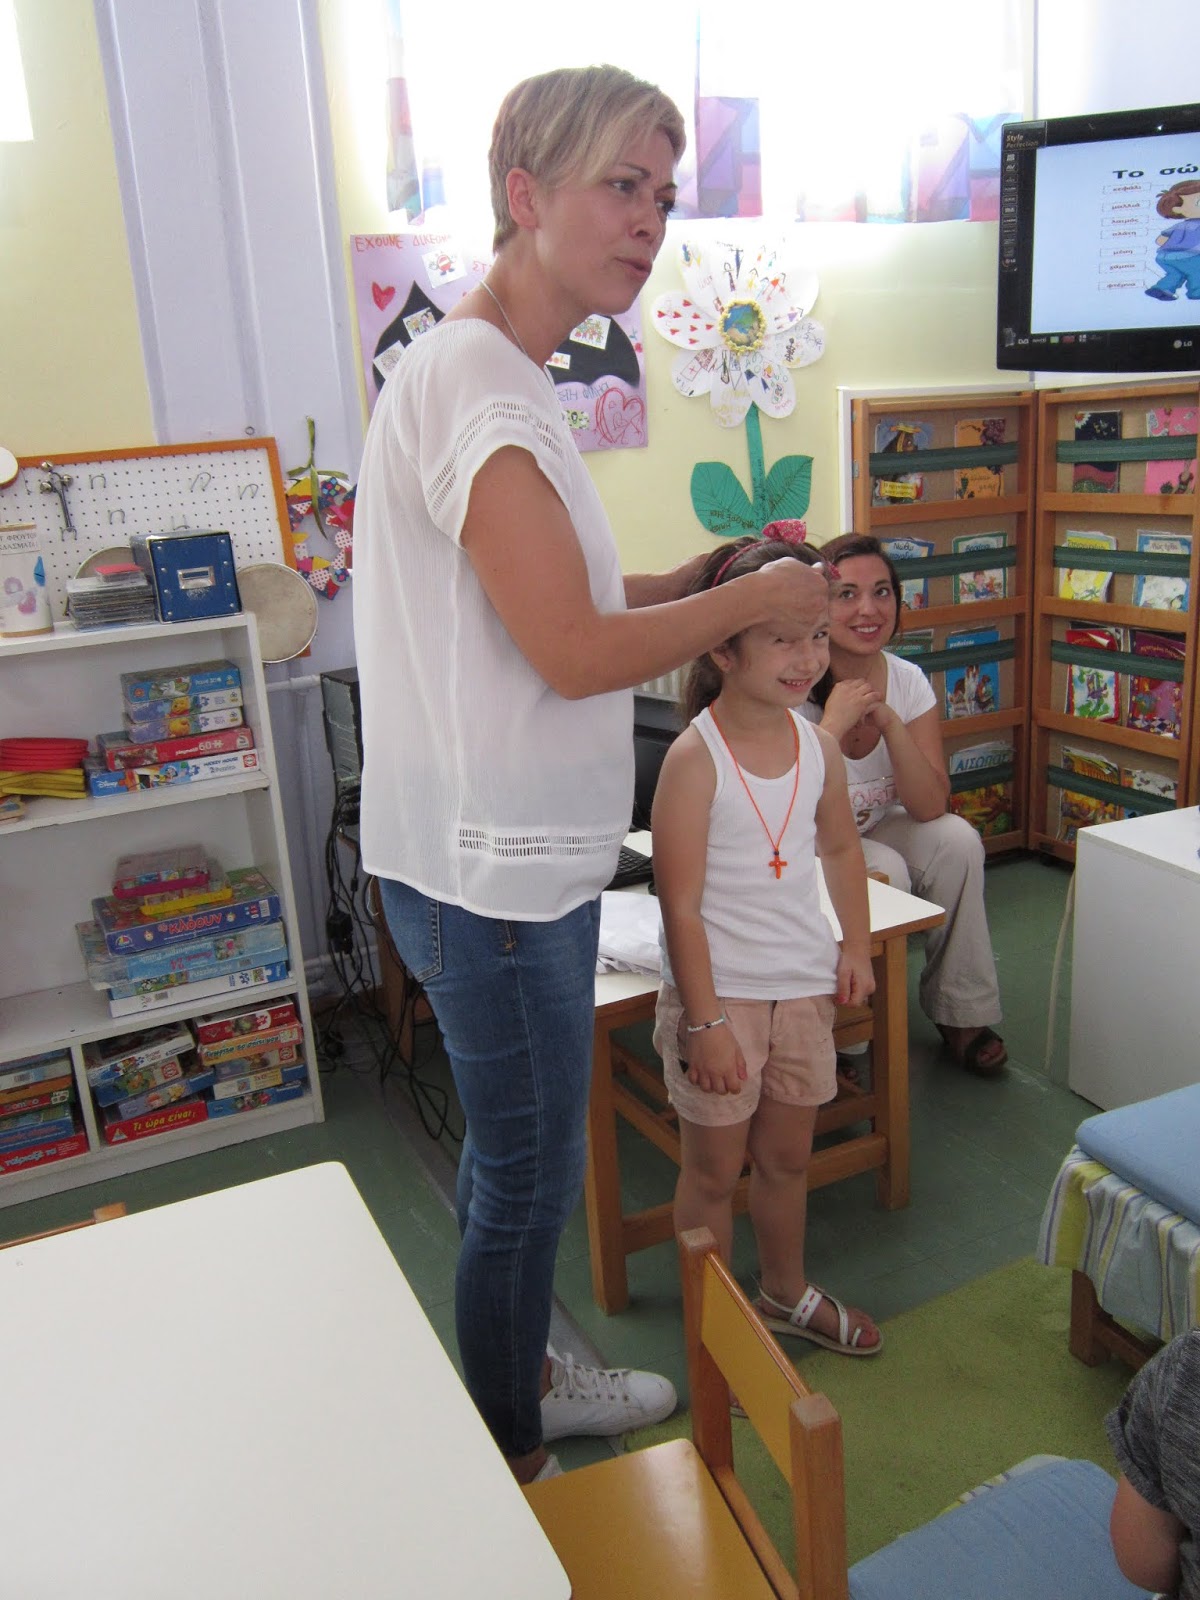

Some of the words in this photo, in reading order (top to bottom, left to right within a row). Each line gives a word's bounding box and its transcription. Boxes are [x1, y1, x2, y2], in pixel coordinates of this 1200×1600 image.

[1006, 133, 1024, 141] Style
[1112, 169, 1145, 179] Το
[198, 741, 212, 751] 60
[145, 1117, 164, 1129] ώρα
